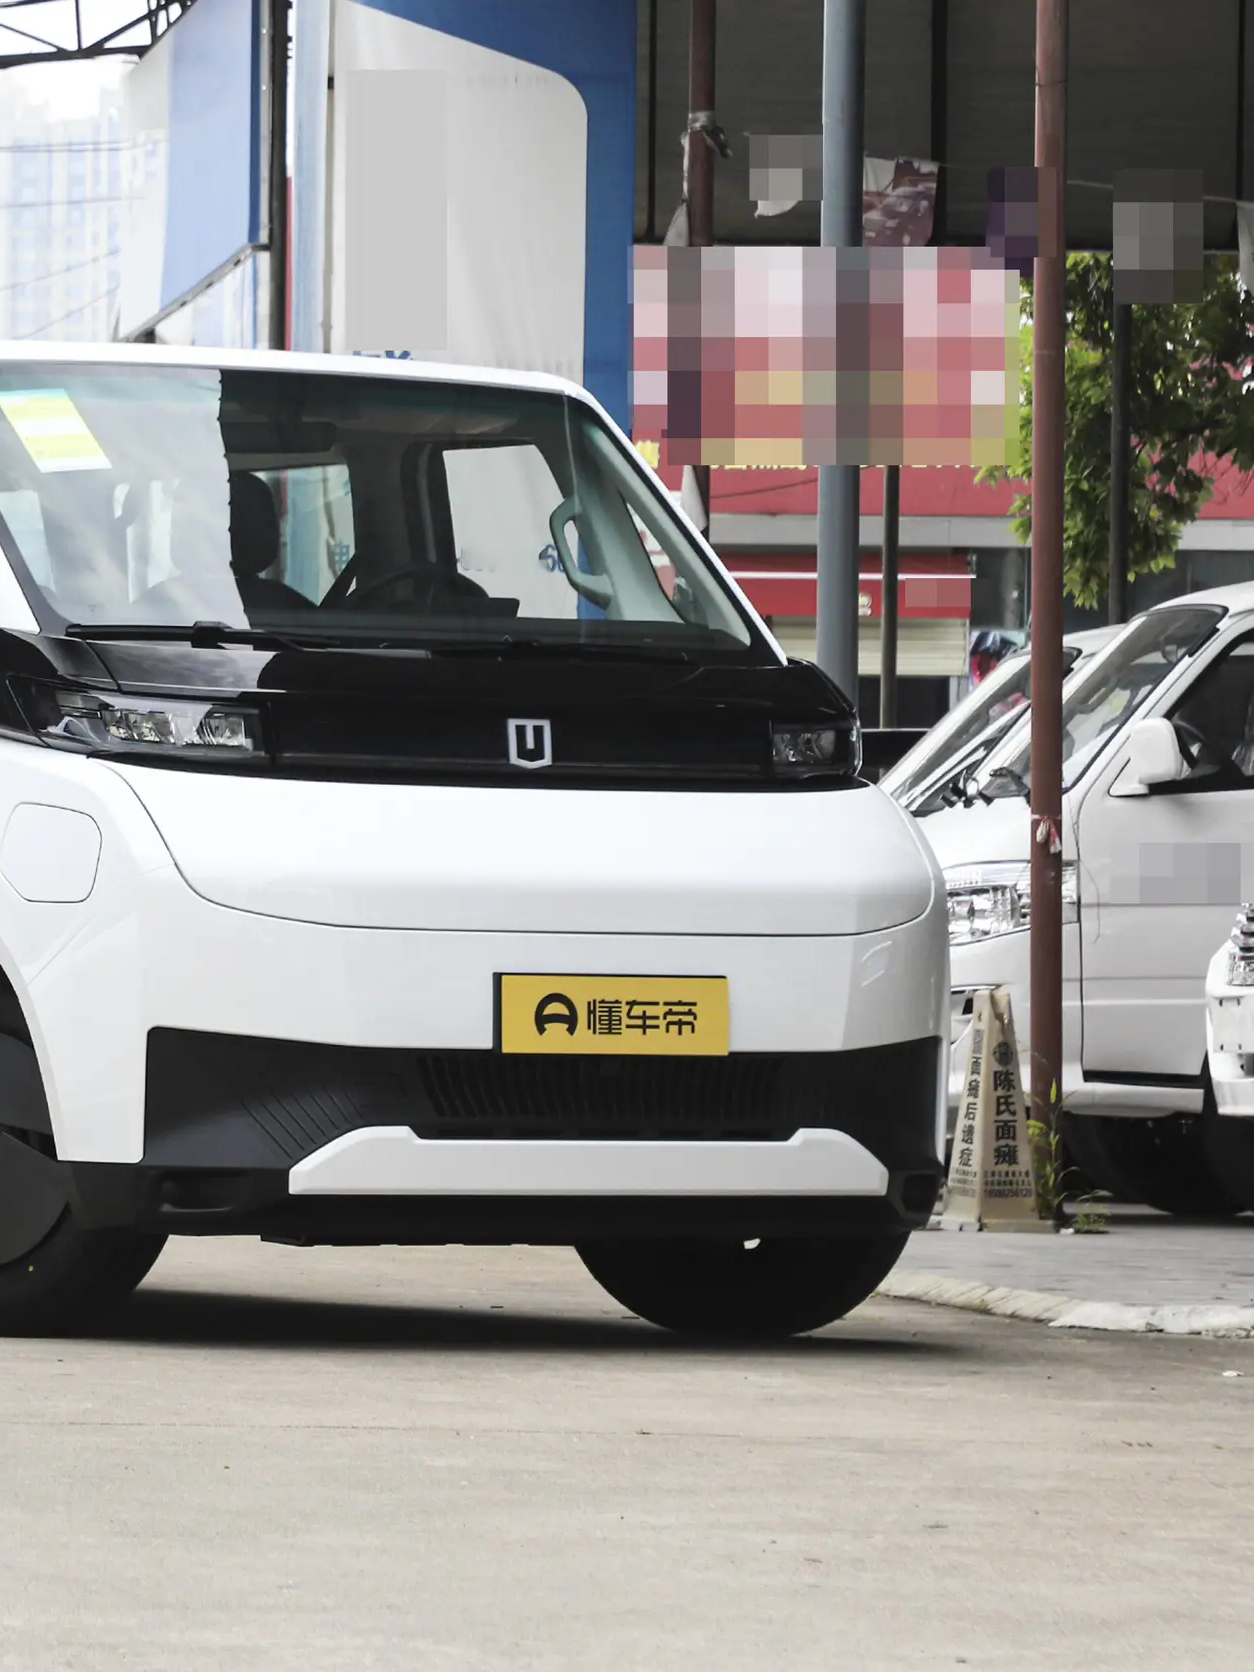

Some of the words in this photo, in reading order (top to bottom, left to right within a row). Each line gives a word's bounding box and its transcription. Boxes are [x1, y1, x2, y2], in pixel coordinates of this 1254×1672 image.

[587, 998, 697, 1036] 懂车帝
[993, 1069, 1019, 1167] 陈氏面瘫
